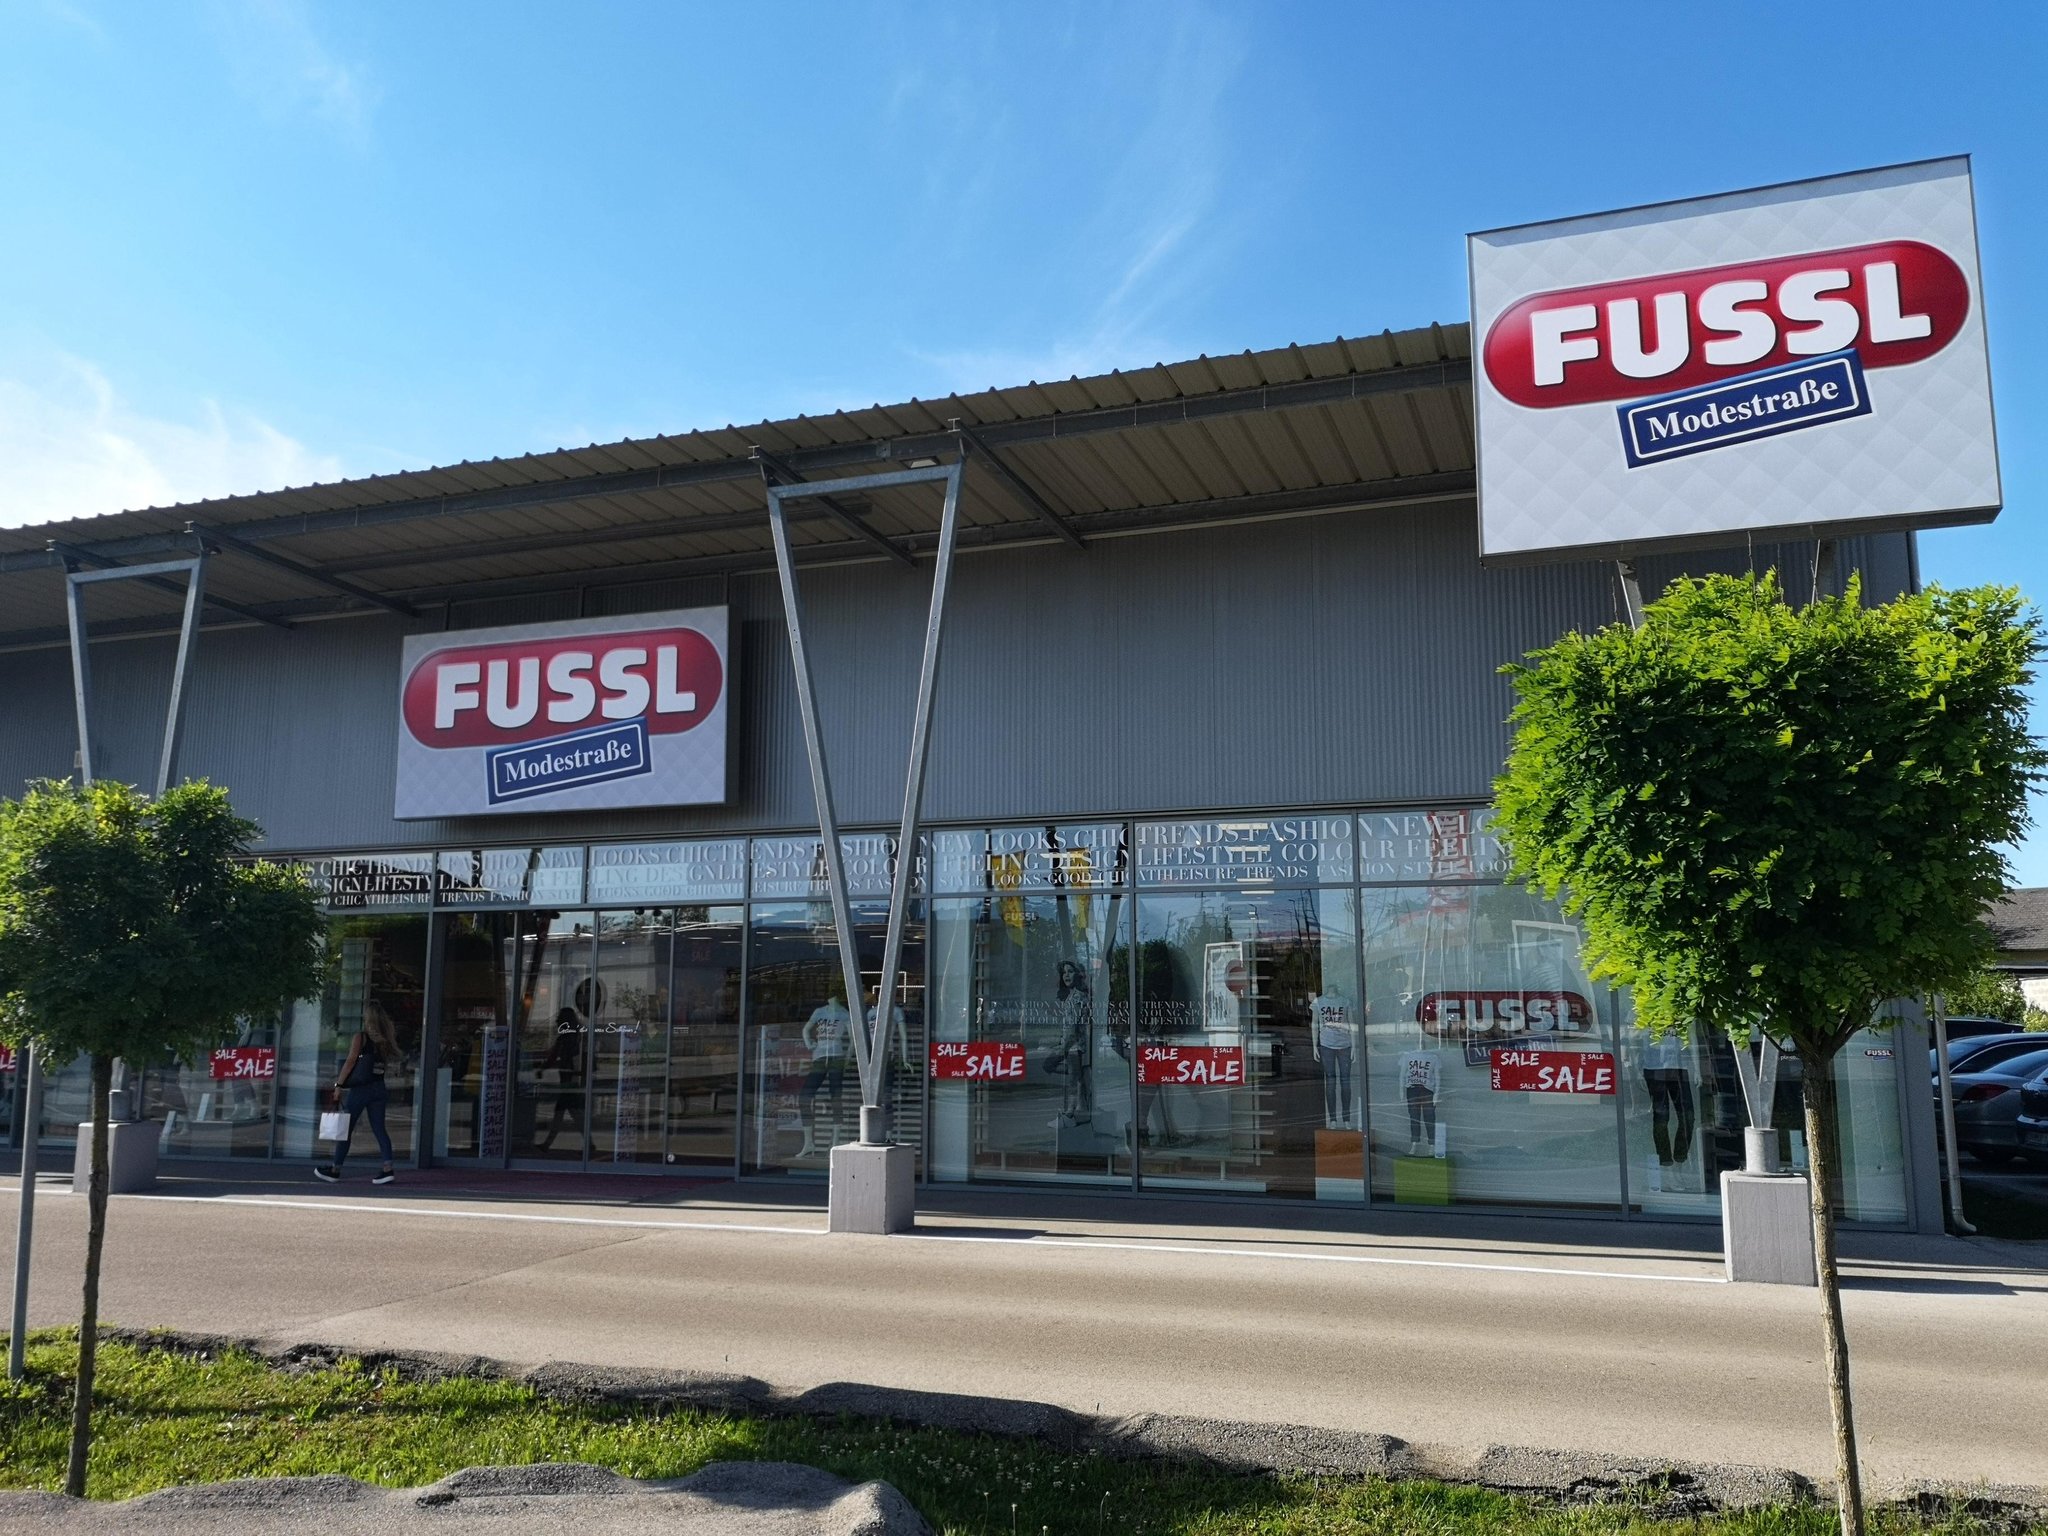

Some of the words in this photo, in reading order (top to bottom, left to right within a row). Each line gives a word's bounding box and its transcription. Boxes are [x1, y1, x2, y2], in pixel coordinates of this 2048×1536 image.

[1530, 261, 1932, 387] FUSSL
[1646, 378, 1840, 442] Modestraße
[435, 645, 696, 729] FUSSL
[504, 739, 632, 783] Modestraße
[985, 830, 1067, 851] LOOKS
[1136, 822, 1239, 846] TRENDS
[1436, 997, 1579, 1032] FUSSL
[215, 1049, 237, 1060] SALE
[937, 1044, 968, 1057] SALE
[1145, 1047, 1178, 1062] SALE
[1500, 1052, 1540, 1067] SALE
[234, 1058, 275, 1078] SALE
[966, 1055, 1023, 1079] SALE
[1177, 1059, 1240, 1085] SALE
[1409, 1060, 1430, 1070] SALE
[1538, 1066, 1612, 1093] SALE
